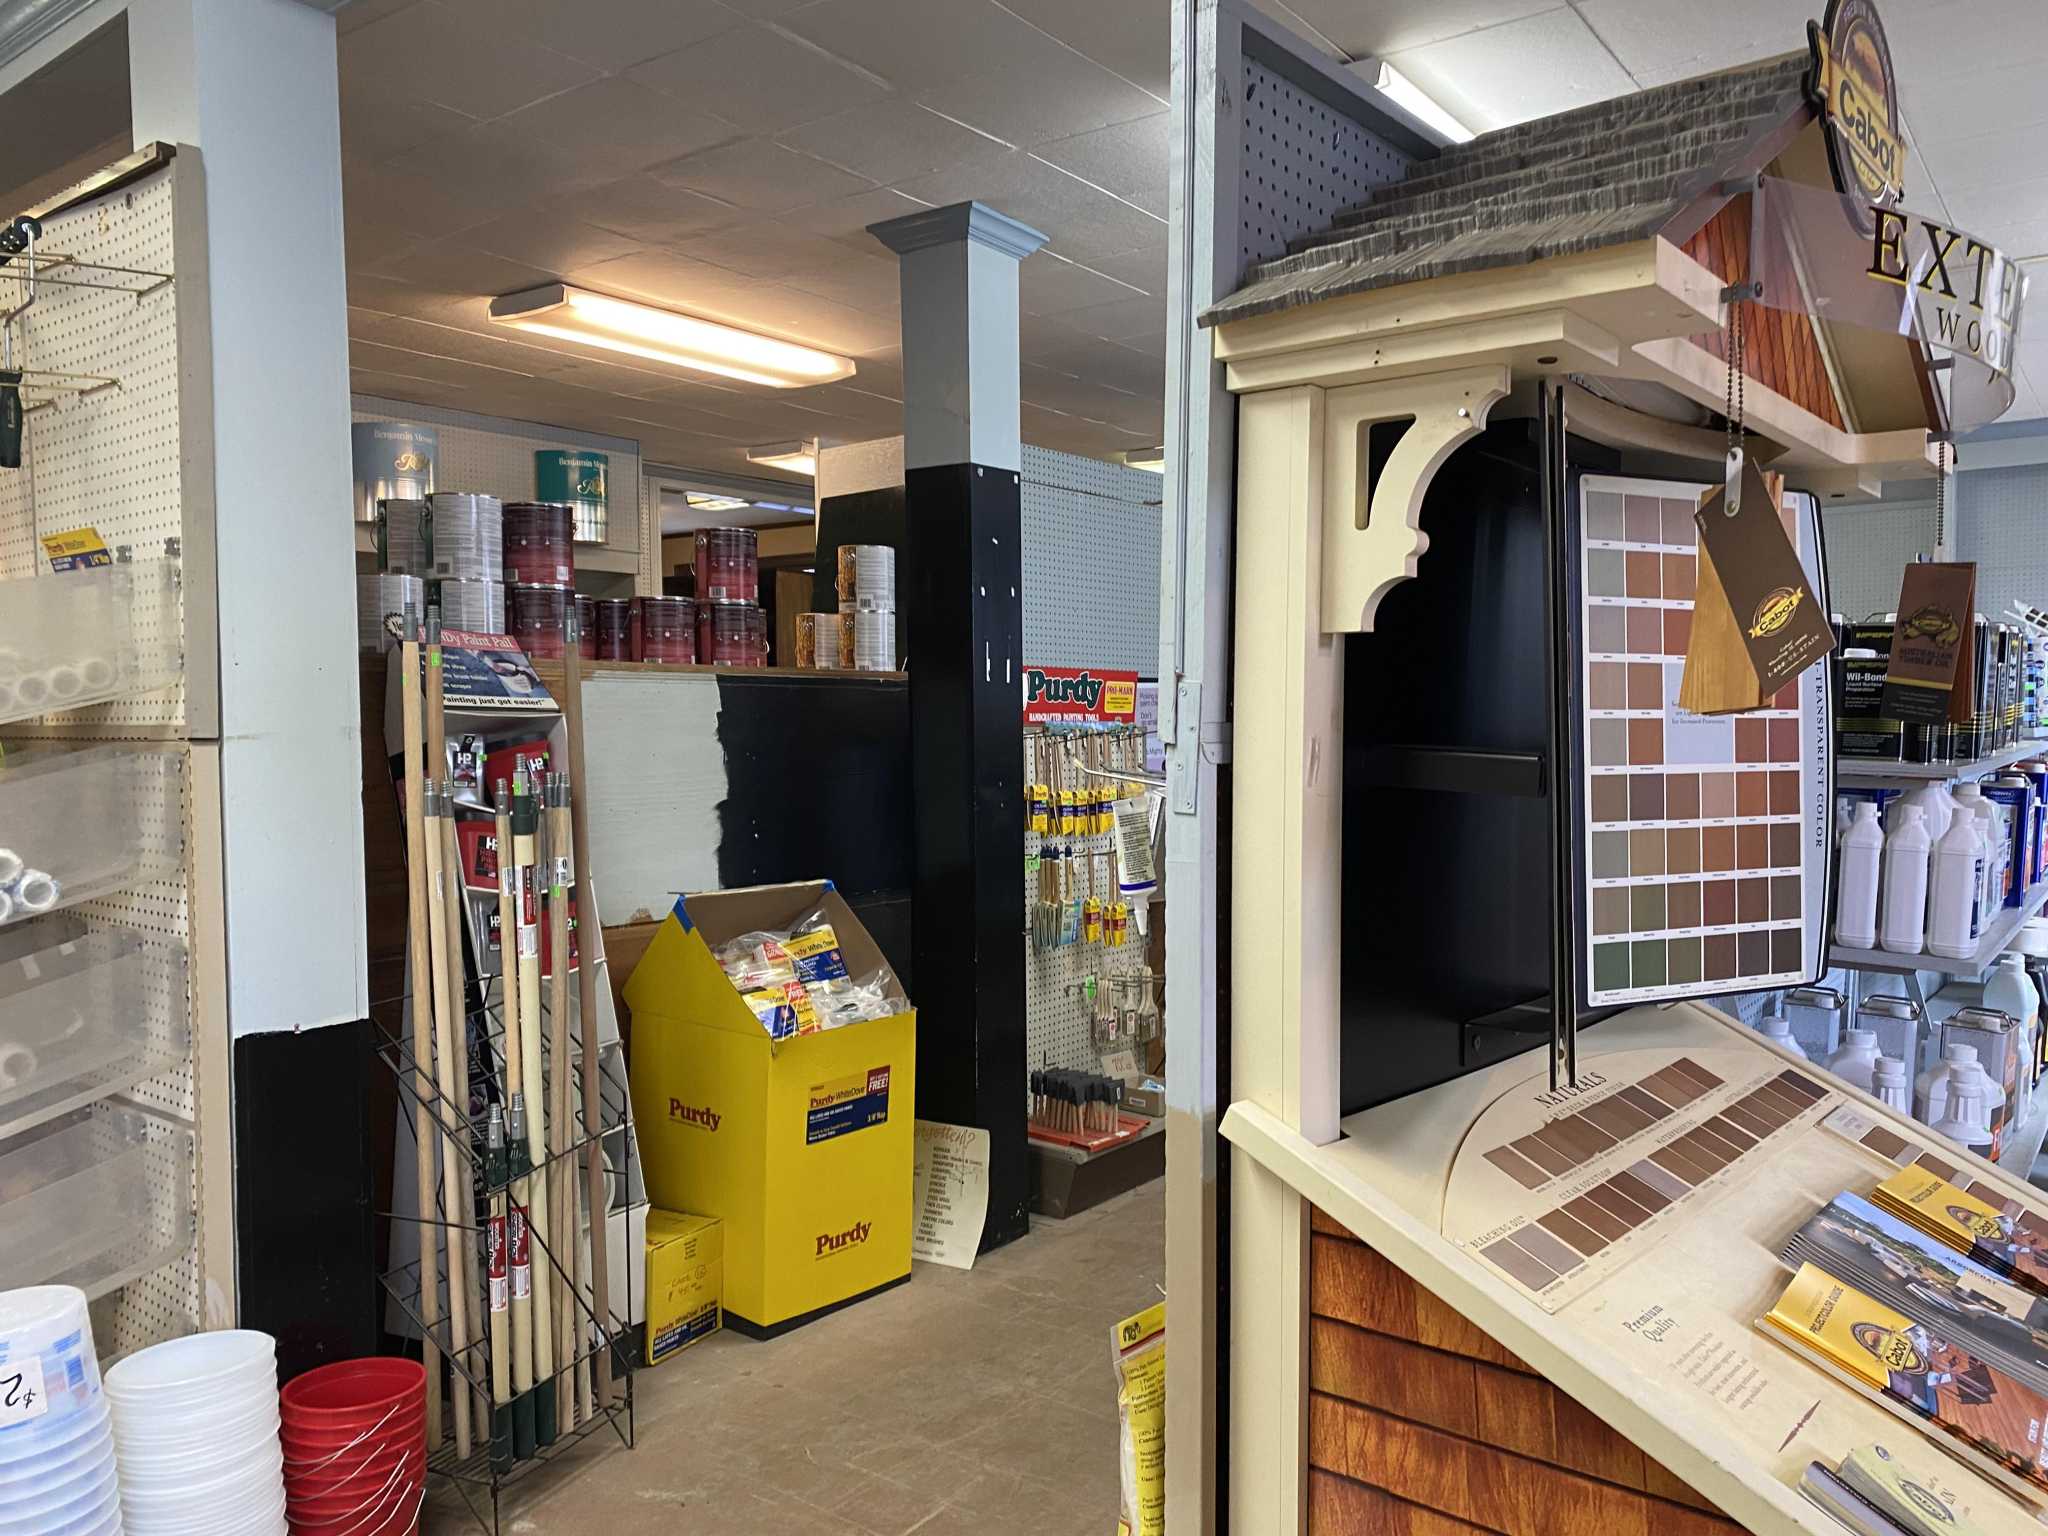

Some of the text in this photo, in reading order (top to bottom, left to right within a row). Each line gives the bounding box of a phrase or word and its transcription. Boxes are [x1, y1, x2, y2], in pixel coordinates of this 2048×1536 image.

[1840, 80, 1896, 180] Cabot
[1866, 207, 2015, 328] EXTE
[374, 429, 413, 441] Benjamin
[559, 457, 592, 467] Benjamin
[1760, 600, 1793, 632] Cabot
[463, 634, 490, 648] Paint
[494, 635, 513, 649] Pail
[479, 697, 495, 705] just
[1028, 670, 1103, 709] Purdy
[1815, 793, 1825, 848] COLOR
[869, 1077, 888, 1092] FREE!
[1534, 1072, 1609, 1109] NATURALS
[669, 1097, 721, 1132] Purdy
[810, 1094, 835, 1108] Purdy
[815, 1221, 872, 1257] Purdy
[1621, 1303, 1665, 1333] Premium
[1641, 1316, 1679, 1343] Quality
[1886, 1338, 1908, 1367] Cabot
